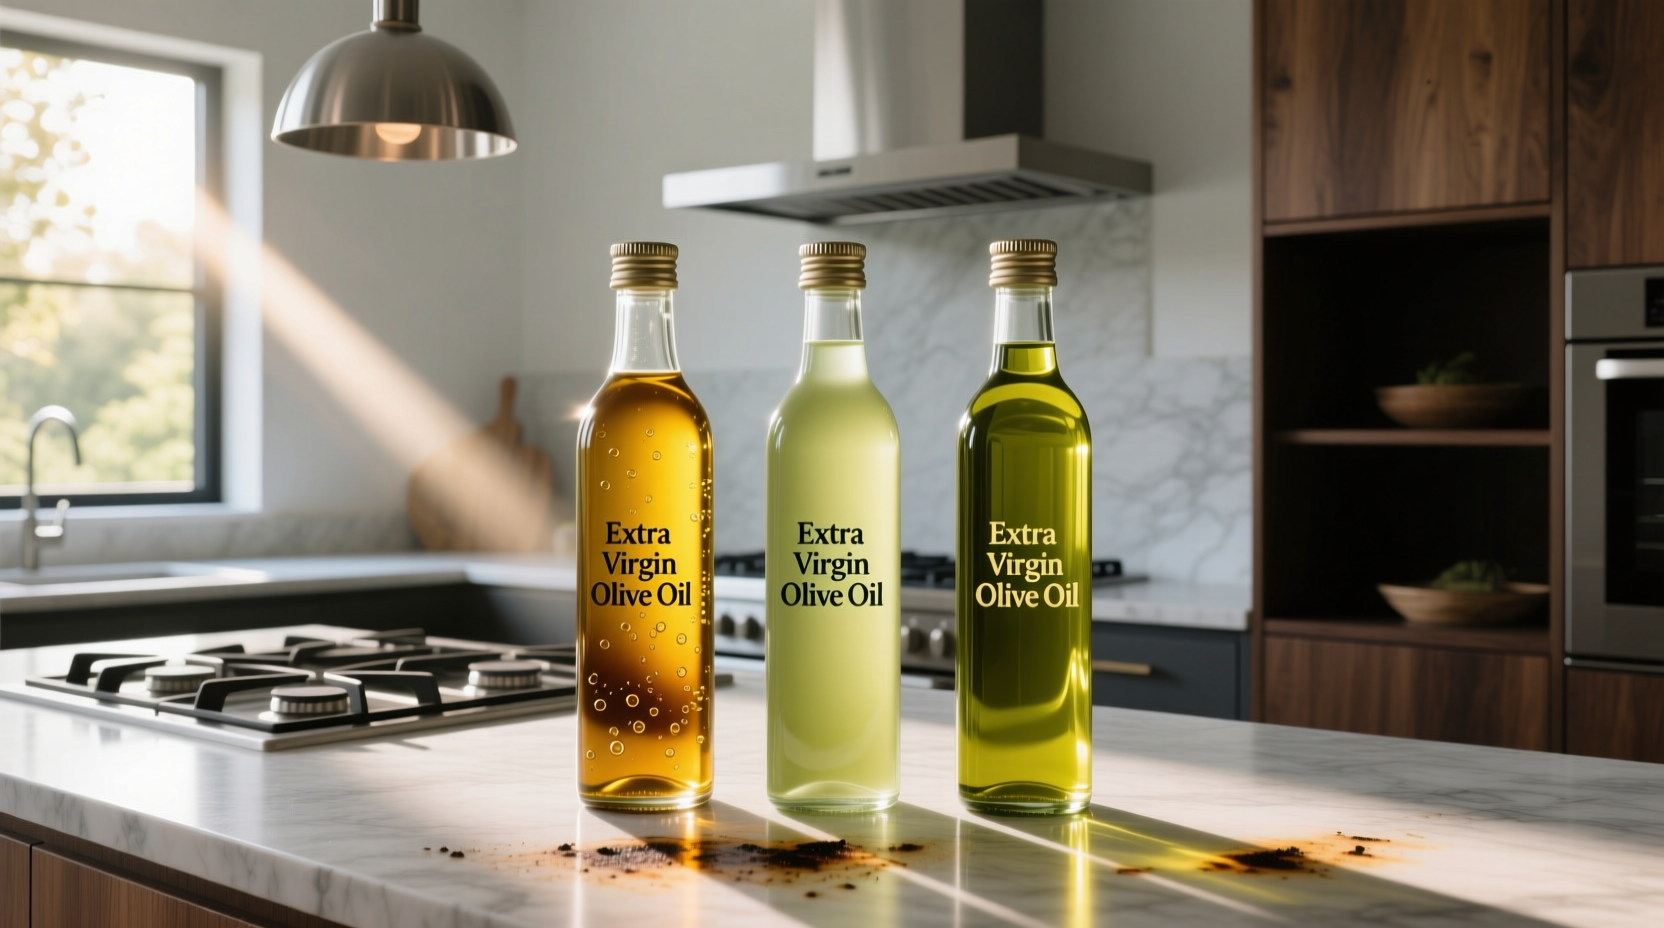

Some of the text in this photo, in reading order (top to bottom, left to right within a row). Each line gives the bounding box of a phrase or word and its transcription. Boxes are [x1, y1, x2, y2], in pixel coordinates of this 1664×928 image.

[605, 521, 671, 545] Extra
[797, 521, 864, 545] Extra
[988, 521, 1057, 545] Extra
[601, 551, 677, 582] Virgin
[793, 551, 870, 582] Virgin
[986, 551, 1064, 583] Virgin
[590, 581, 692, 607] Olive Oil
[780, 581, 884, 607] Olive Oil
[975, 581, 1079, 608] Olive Oil
